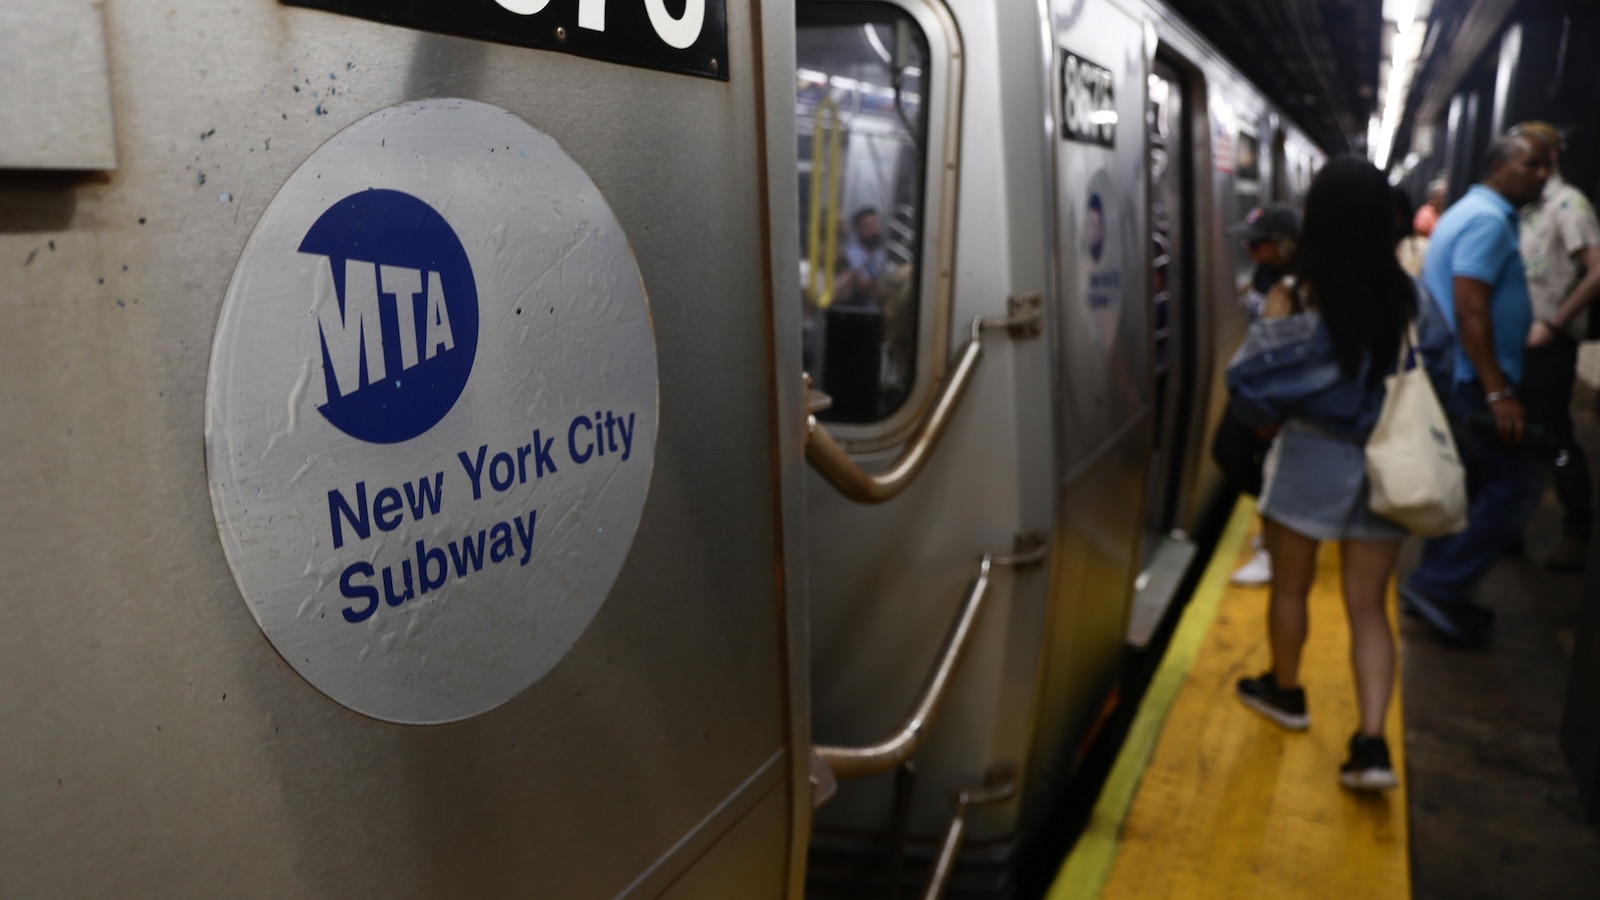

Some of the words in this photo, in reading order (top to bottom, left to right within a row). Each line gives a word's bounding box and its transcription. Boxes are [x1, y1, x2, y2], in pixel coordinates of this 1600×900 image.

[300, 251, 455, 400] MTA
[327, 472, 444, 549] New
[457, 430, 557, 501] York
[568, 410, 636, 462] City
[339, 510, 537, 623] Subway
